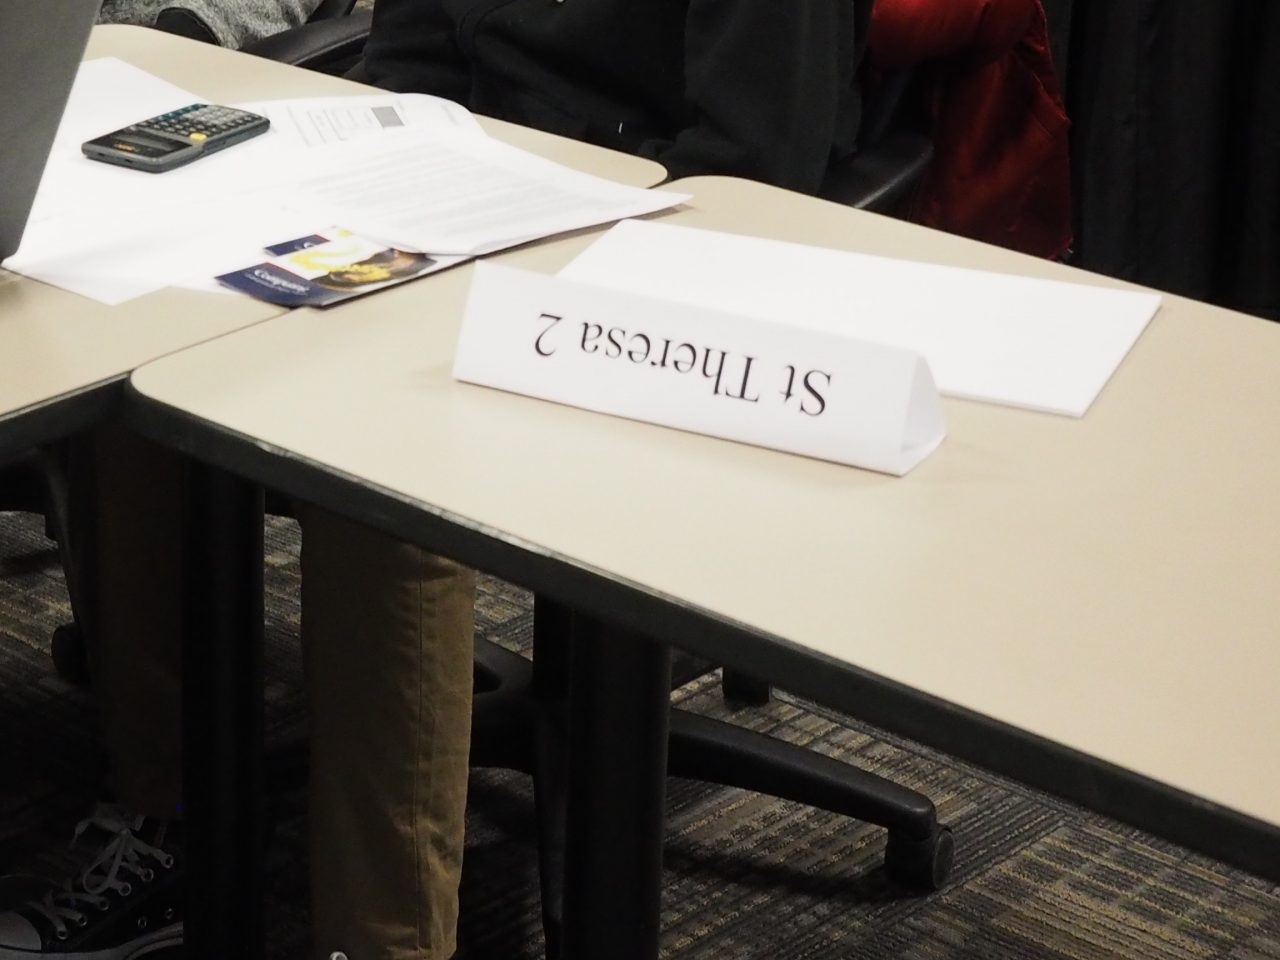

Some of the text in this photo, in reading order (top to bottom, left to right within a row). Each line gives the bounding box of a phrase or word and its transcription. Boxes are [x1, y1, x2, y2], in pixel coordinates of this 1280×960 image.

[534, 312, 833, 417] St Theresa 2
